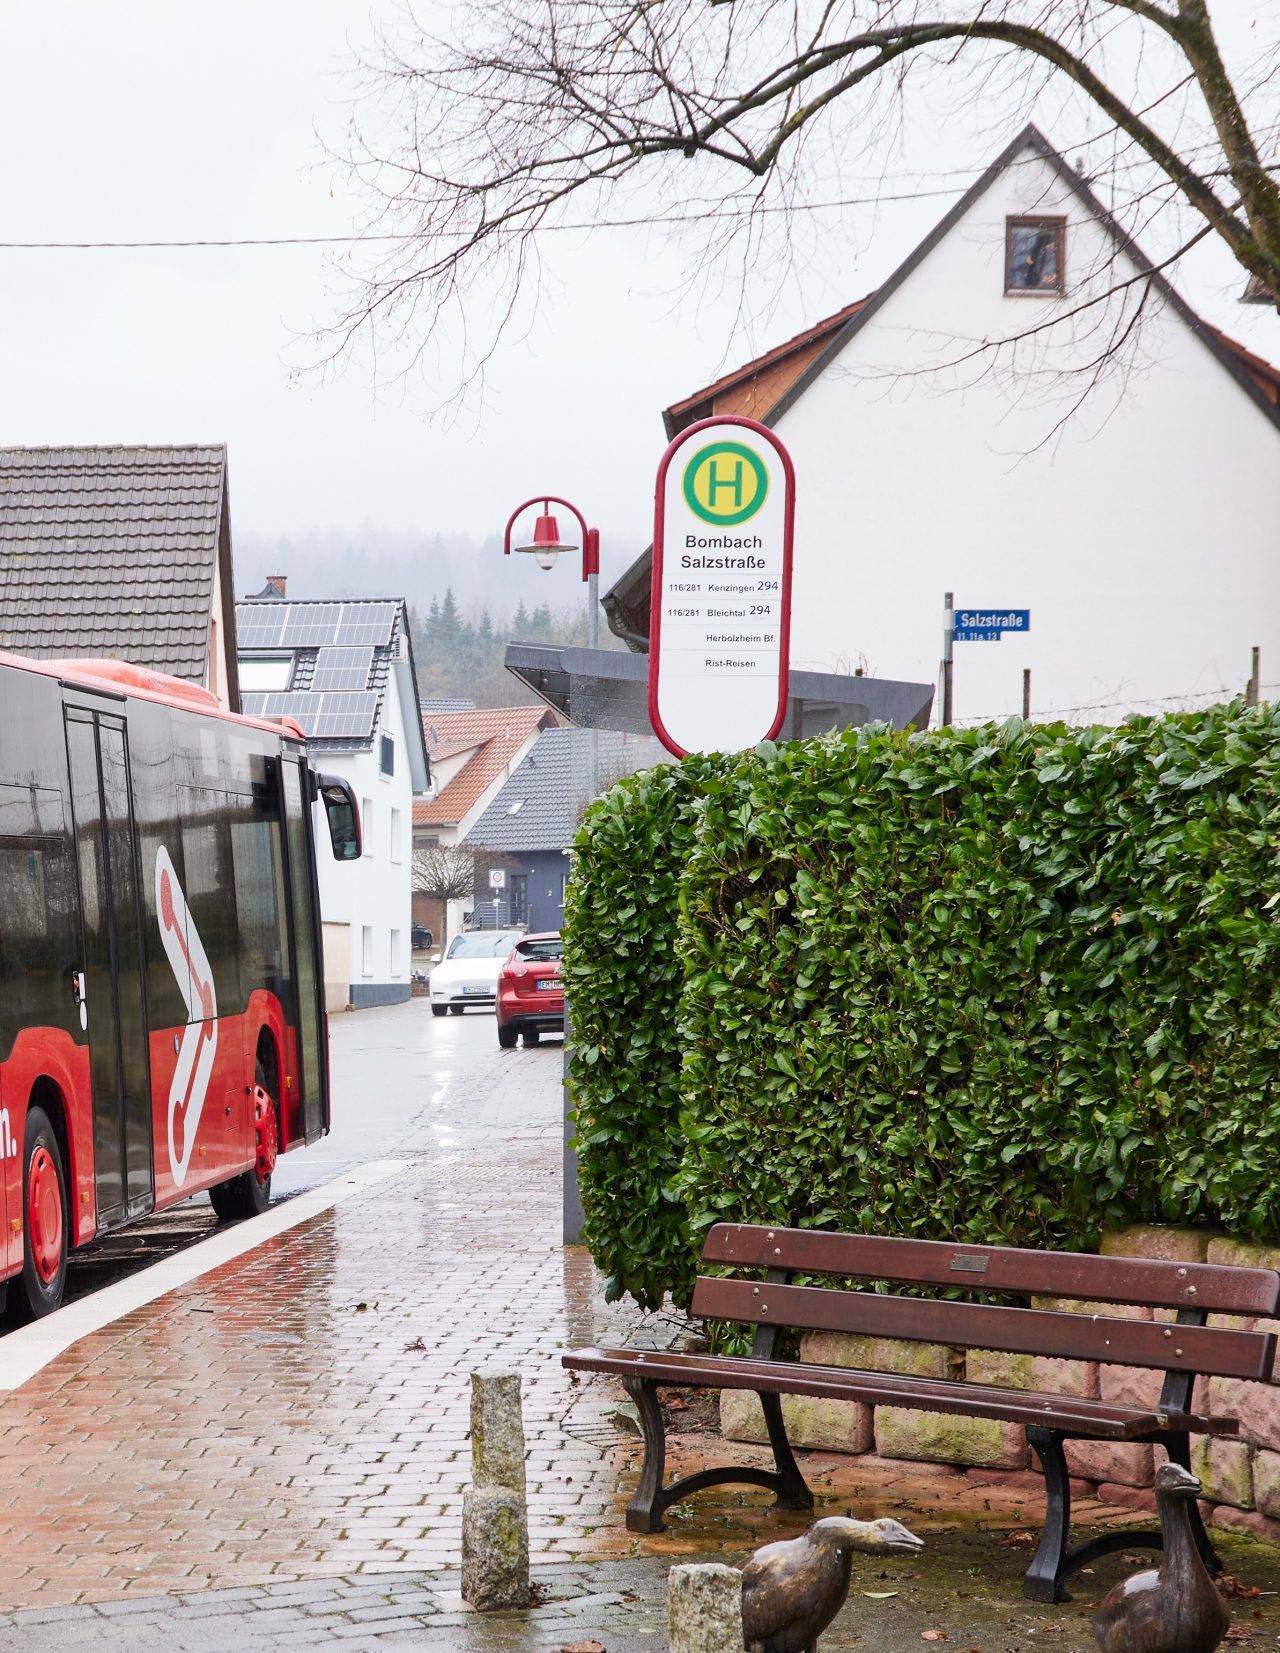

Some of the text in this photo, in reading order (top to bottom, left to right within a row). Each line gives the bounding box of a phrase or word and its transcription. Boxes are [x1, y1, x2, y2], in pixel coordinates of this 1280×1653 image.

[708, 461, 743, 507] H
[685, 535, 762, 548] Bombach
[681, 555, 766, 568] Salzstraße
[669, 580, 779, 593] 116/281 Kenzingen 294
[668, 605, 771, 617] 116/281 Bleichtal 294
[961, 613, 1023, 627] Salzstraße
[706, 634, 776, 642] Herbolzheim Bf.
[705, 659, 756, 668] Rist-Reisen
